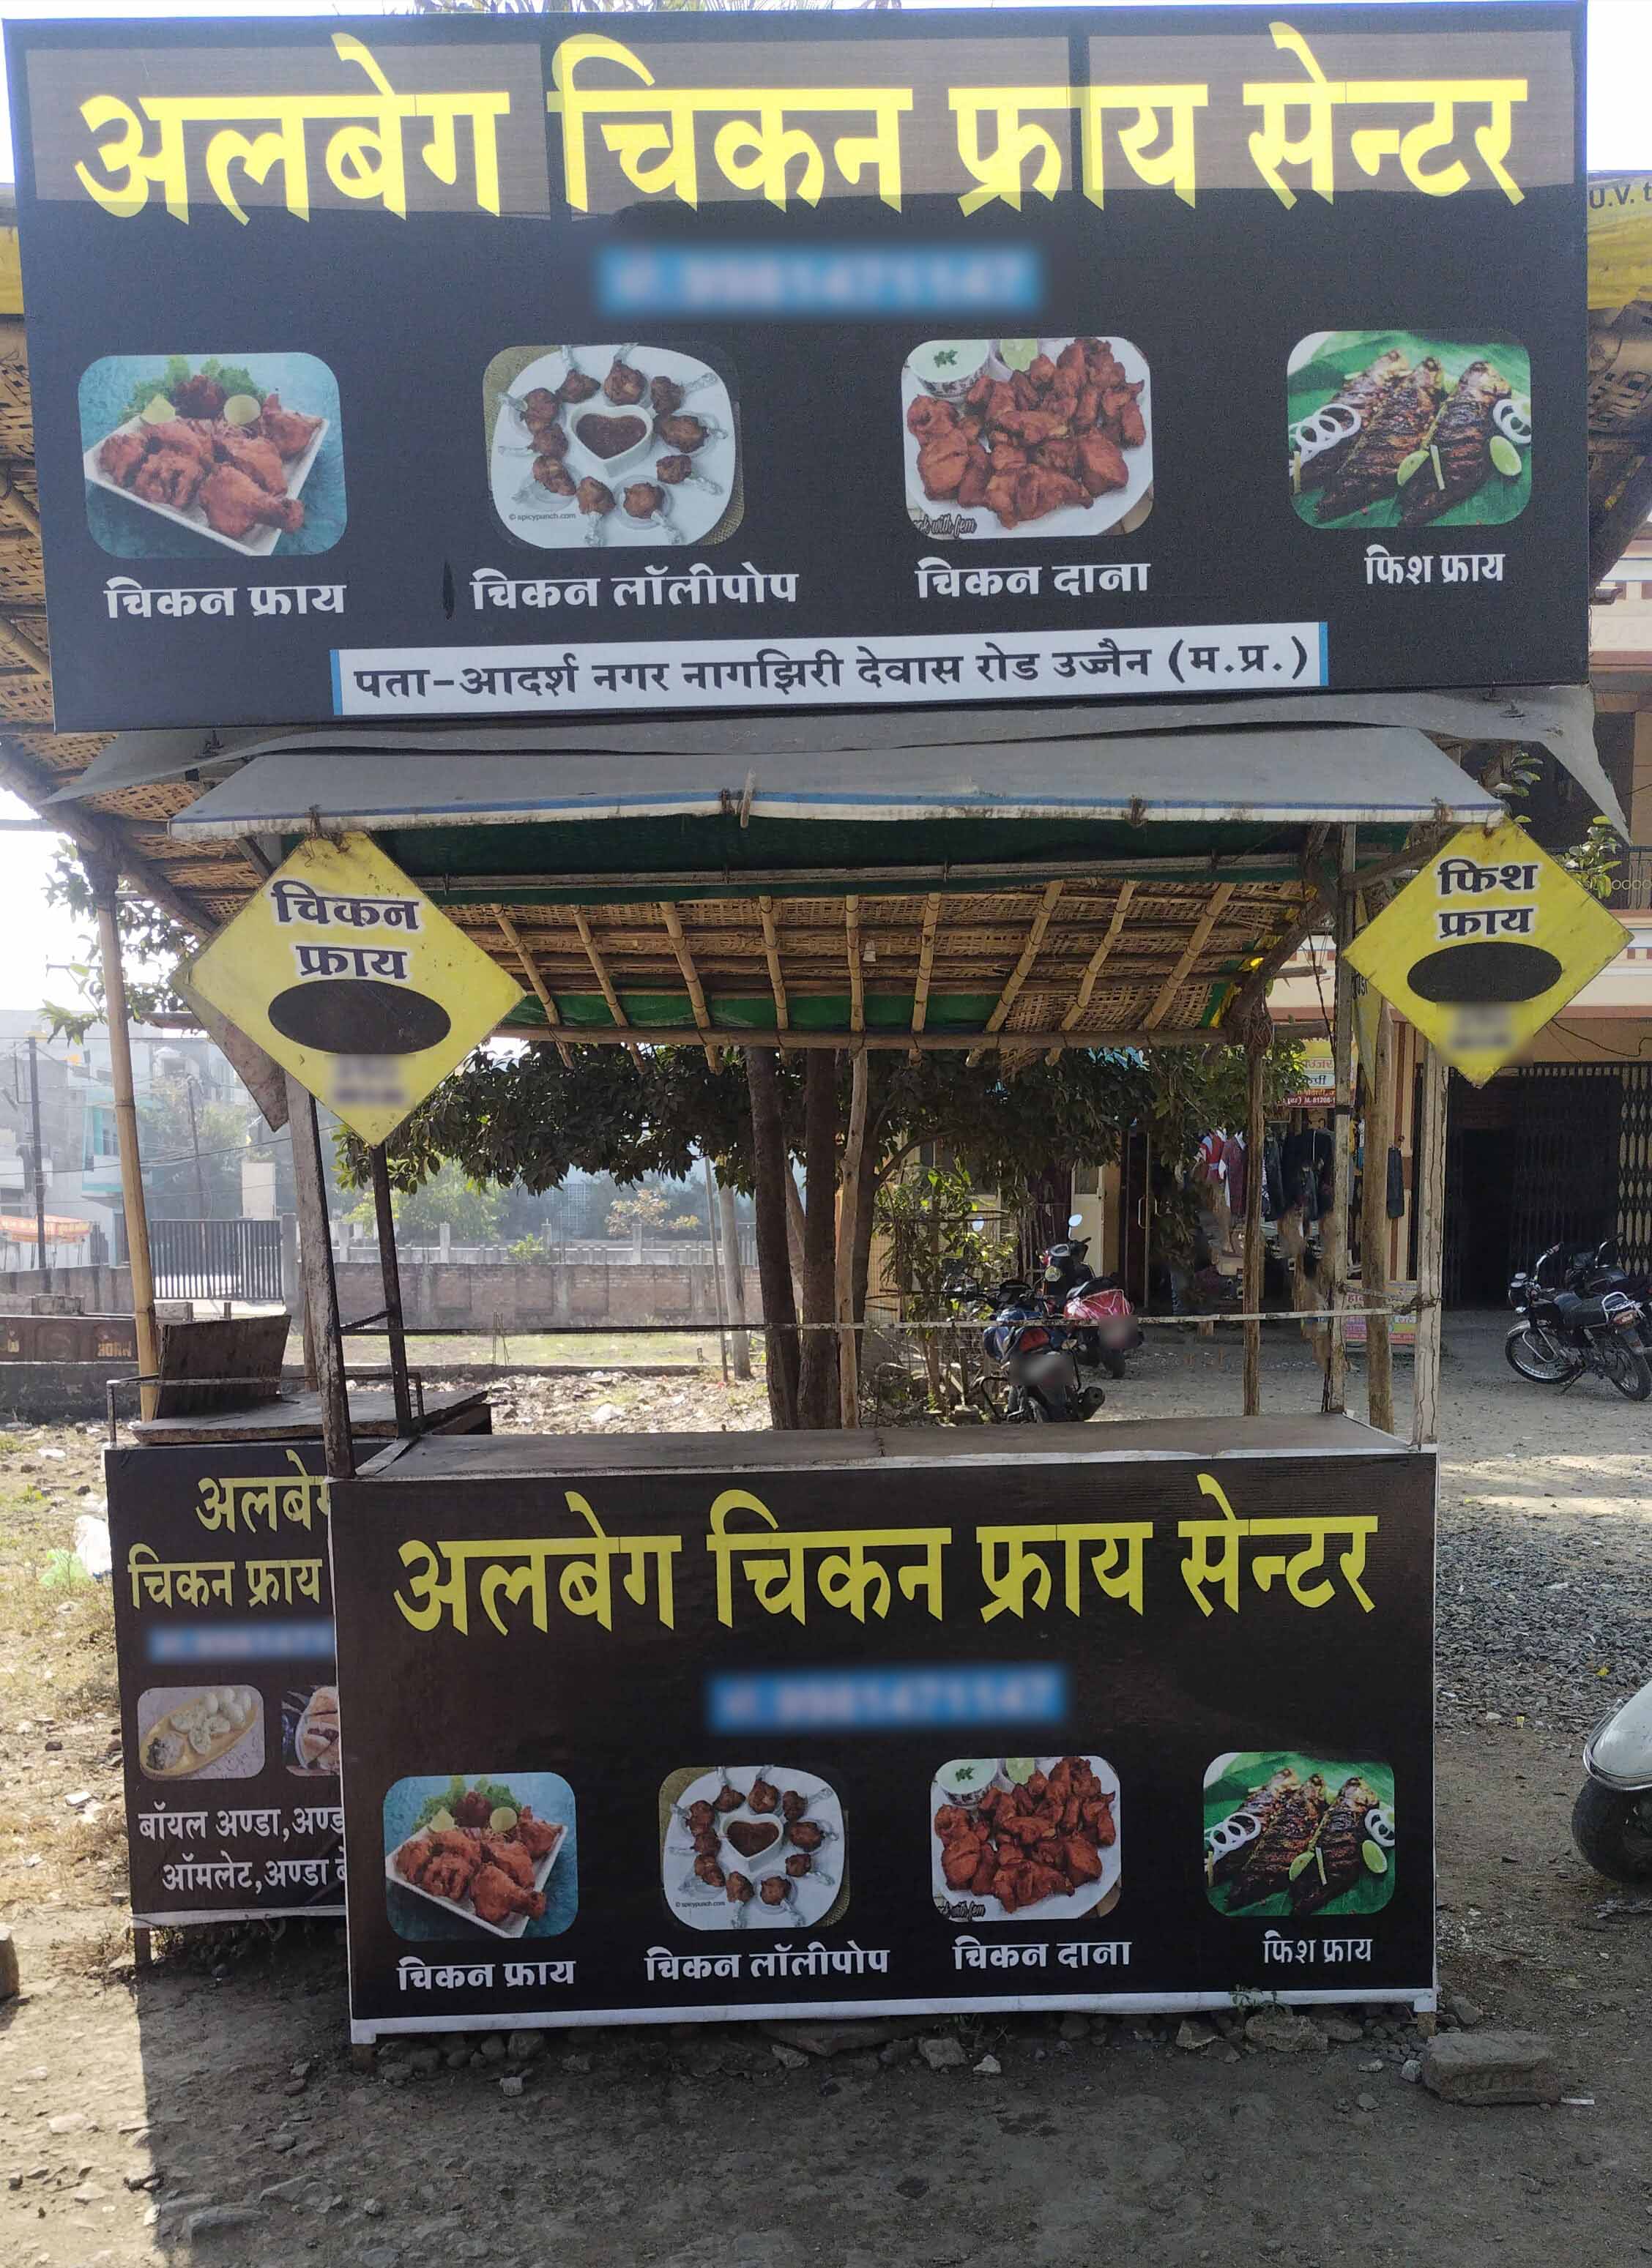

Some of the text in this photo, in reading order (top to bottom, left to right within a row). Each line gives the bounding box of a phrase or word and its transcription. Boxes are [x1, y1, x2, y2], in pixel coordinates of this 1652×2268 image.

[75, 22, 1528, 226] अलबेग चिकन फ्राय सेन्टर
[469, 561, 800, 609] चिकन लॉलीपोप
[914, 556, 1151, 598] चिकन दाना
[1364, 544, 1506, 585] फिश फ्राय
[103, 576, 347, 619] चिकन फ्राय
[591, 663, 670, 692] नगर
[681, 648, 844, 695] नागझिरी
[855, 645, 964, 688] देवास
[975, 641, 1041, 682] रोड
[1052, 637, 1153, 678] उज्जैन
[1437, 859, 1538, 896] फिश
[270, 879, 420, 930] चिकन
[1439, 908, 1534, 939] फ्राय
[296, 945, 407, 980] फ्राय
[393, 1473, 1379, 1635] अलबेग चिकन फ्राय सेन्टर
[127, 1543, 322, 1609] चिकन फ्राय
[138, 1801, 208, 1840] बॉयल
[644, 1940, 890, 1981] चिकन लॉलीपोप
[953, 1935, 1132, 1969] चिकन दाना
[1264, 1930, 1373, 1964] फिश फ्राय
[397, 1956, 576, 1991] चिकन फ्राय
